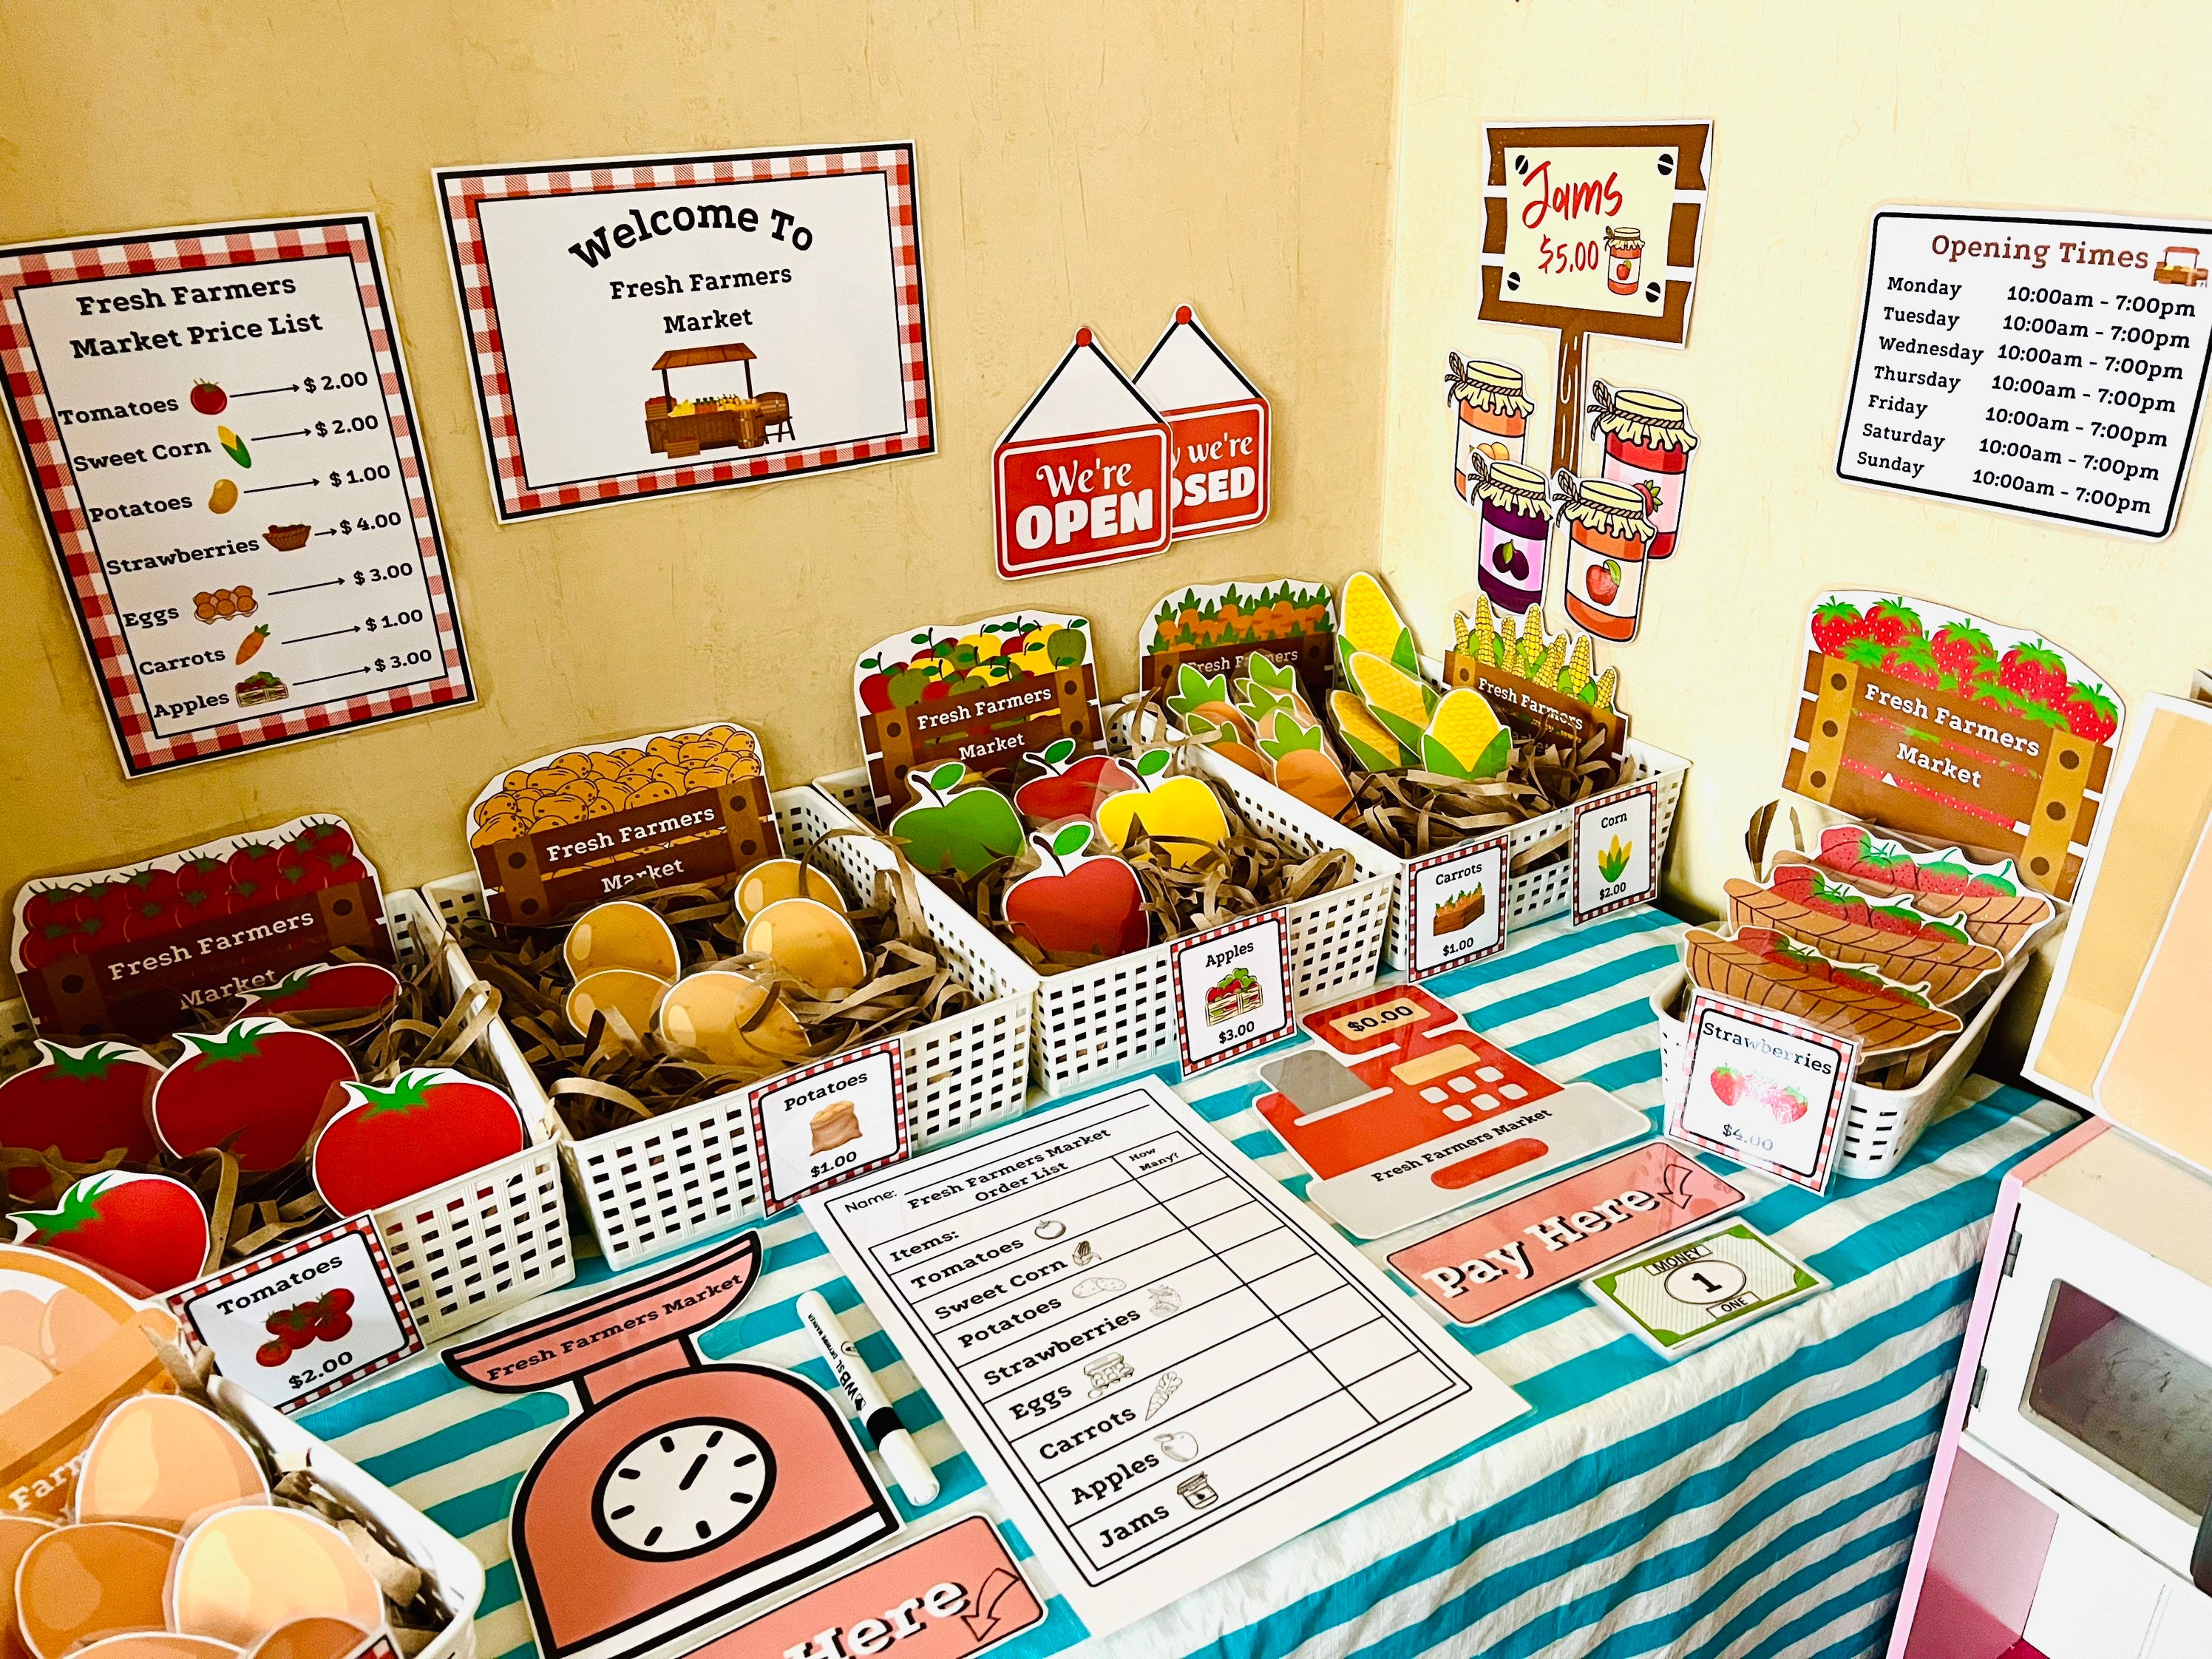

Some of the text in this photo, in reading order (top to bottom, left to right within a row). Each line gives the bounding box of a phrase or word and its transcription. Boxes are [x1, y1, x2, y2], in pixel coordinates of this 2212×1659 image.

[1522, 161, 1622, 228] Jams
[569, 202, 813, 268] Welcome To
[1538, 234, 1598, 274] $5.00
[1933, 234, 2148, 269] Opening Times
[76, 276, 296, 316] Fresh Farmers
[610, 267, 793, 300] Fresh Farmers
[1887, 276, 1962, 299] Monday
[2008, 286, 2093, 308] 10:00am
[2116, 296, 2196, 319] 7:00pm
[70, 312, 324, 359] Market Price List
[663, 308, 753, 334] Market
[1883, 307, 1960, 330] Tuesday
[2003, 316, 2089, 338] 10:00am
[2111, 325, 2190, 350] 7:00pm
[1879, 336, 1984, 364] Wednesday
[1998, 345, 2083, 367] 10:00am
[2105, 356, 2183, 381] 7:00pm
[1874, 366, 1961, 393] Thursday
[1992, 376, 2076, 399] 10:00am
[2097, 389, 2176, 414] 7:00pm
[58, 396, 179, 426] Tomatoes
[1867, 395, 1927, 418] Friday
[1985, 407, 2069, 432] 10:00am
[2091, 422, 2168, 447] 7:00pm
[74, 445, 149, 472] Sweet
[152, 439, 211, 461] Corn
[1187, 432, 1253, 463] we're
[1862, 423, 1945, 451] Saturday
[1979, 438, 2061, 464] 10:00am
[2083, 455, 2159, 481] 7:00pm
[1037, 458, 1132, 498] We're
[1857, 452, 1924, 477] Sunday
[1972, 469, 2054, 496] 10:00am
[2076, 487, 2151, 514] 7:00pm
[89, 494, 193, 523] Potatoes
[1016, 489, 1153, 549] OPEN
[106, 538, 260, 576] Strawberries
[124, 605, 179, 629] Eggs
[139, 648, 226, 676] Carrots
[1235, 651, 1298, 668] Faers
[154, 691, 230, 719] Apples
[917, 688, 1052, 730] Fresh Farmers
[1479, 677, 1517, 703] Fresh
[1865, 683, 2040, 757] Fresh Farmers
[959, 733, 1025, 761] Market
[1896, 743, 1983, 788] Market
[546, 809, 716, 863] Fresh Farmers
[1601, 812, 1628, 829] Corn
[1436, 863, 1482, 886] Carrots
[1599, 882, 1626, 900] $2.00
[108, 912, 314, 980] Fresh Farmers
[1205, 941, 1254, 968] Apples
[1443, 937, 1474, 957] $1.00
[1218, 1021, 1255, 1044] $3.00
[1347, 1005, 1414, 1032] $0.00
[1703, 1022, 1832, 1075] Strawberries
[784, 1073, 868, 1111] Potatoes
[1128, 1147, 1156, 1161] How
[1371, 1108, 1553, 1184] Fresh Farmers Market
[1723, 1123, 1773, 1150] $4.00
[810, 1151, 857, 1178] $1.00
[907, 1127, 1112, 1210] Fresh Farmers Market
[1139, 1151, 1180, 1172] Many?
[844, 1187, 897, 1214] Name:
[974, 1161, 1068, 1203] Order List
[889, 1228, 960, 1263] Items:
[911, 1237, 1024, 1289] Tomatoes
[1420, 1187, 1662, 1300] Pay Here
[1652, 1247, 1701, 1272] MONEY
[216, 1256, 343, 1315] Tomatoes
[935, 1256, 1068, 1320] Sweet Corn
[1692, 1272, 1723, 1292] 1
[957, 1295, 1062, 1348] Potatoes
[1721, 1297, 1748, 1312] ONE
[487, 1274, 744, 1381] Fresh Farmers Market
[983, 1309, 1141, 1385] Strawberries
[288, 1351, 353, 1389] $2.00
[840, 1371, 858, 1400] WB
[1008, 1384, 1073, 1421] Eggs
[1039, 1408, 1136, 1460] Carrots
[1071, 1453, 1160, 1505] Apples
[1098, 1504, 1170, 1549] Jams
[783, 1582, 970, 1659] Here
